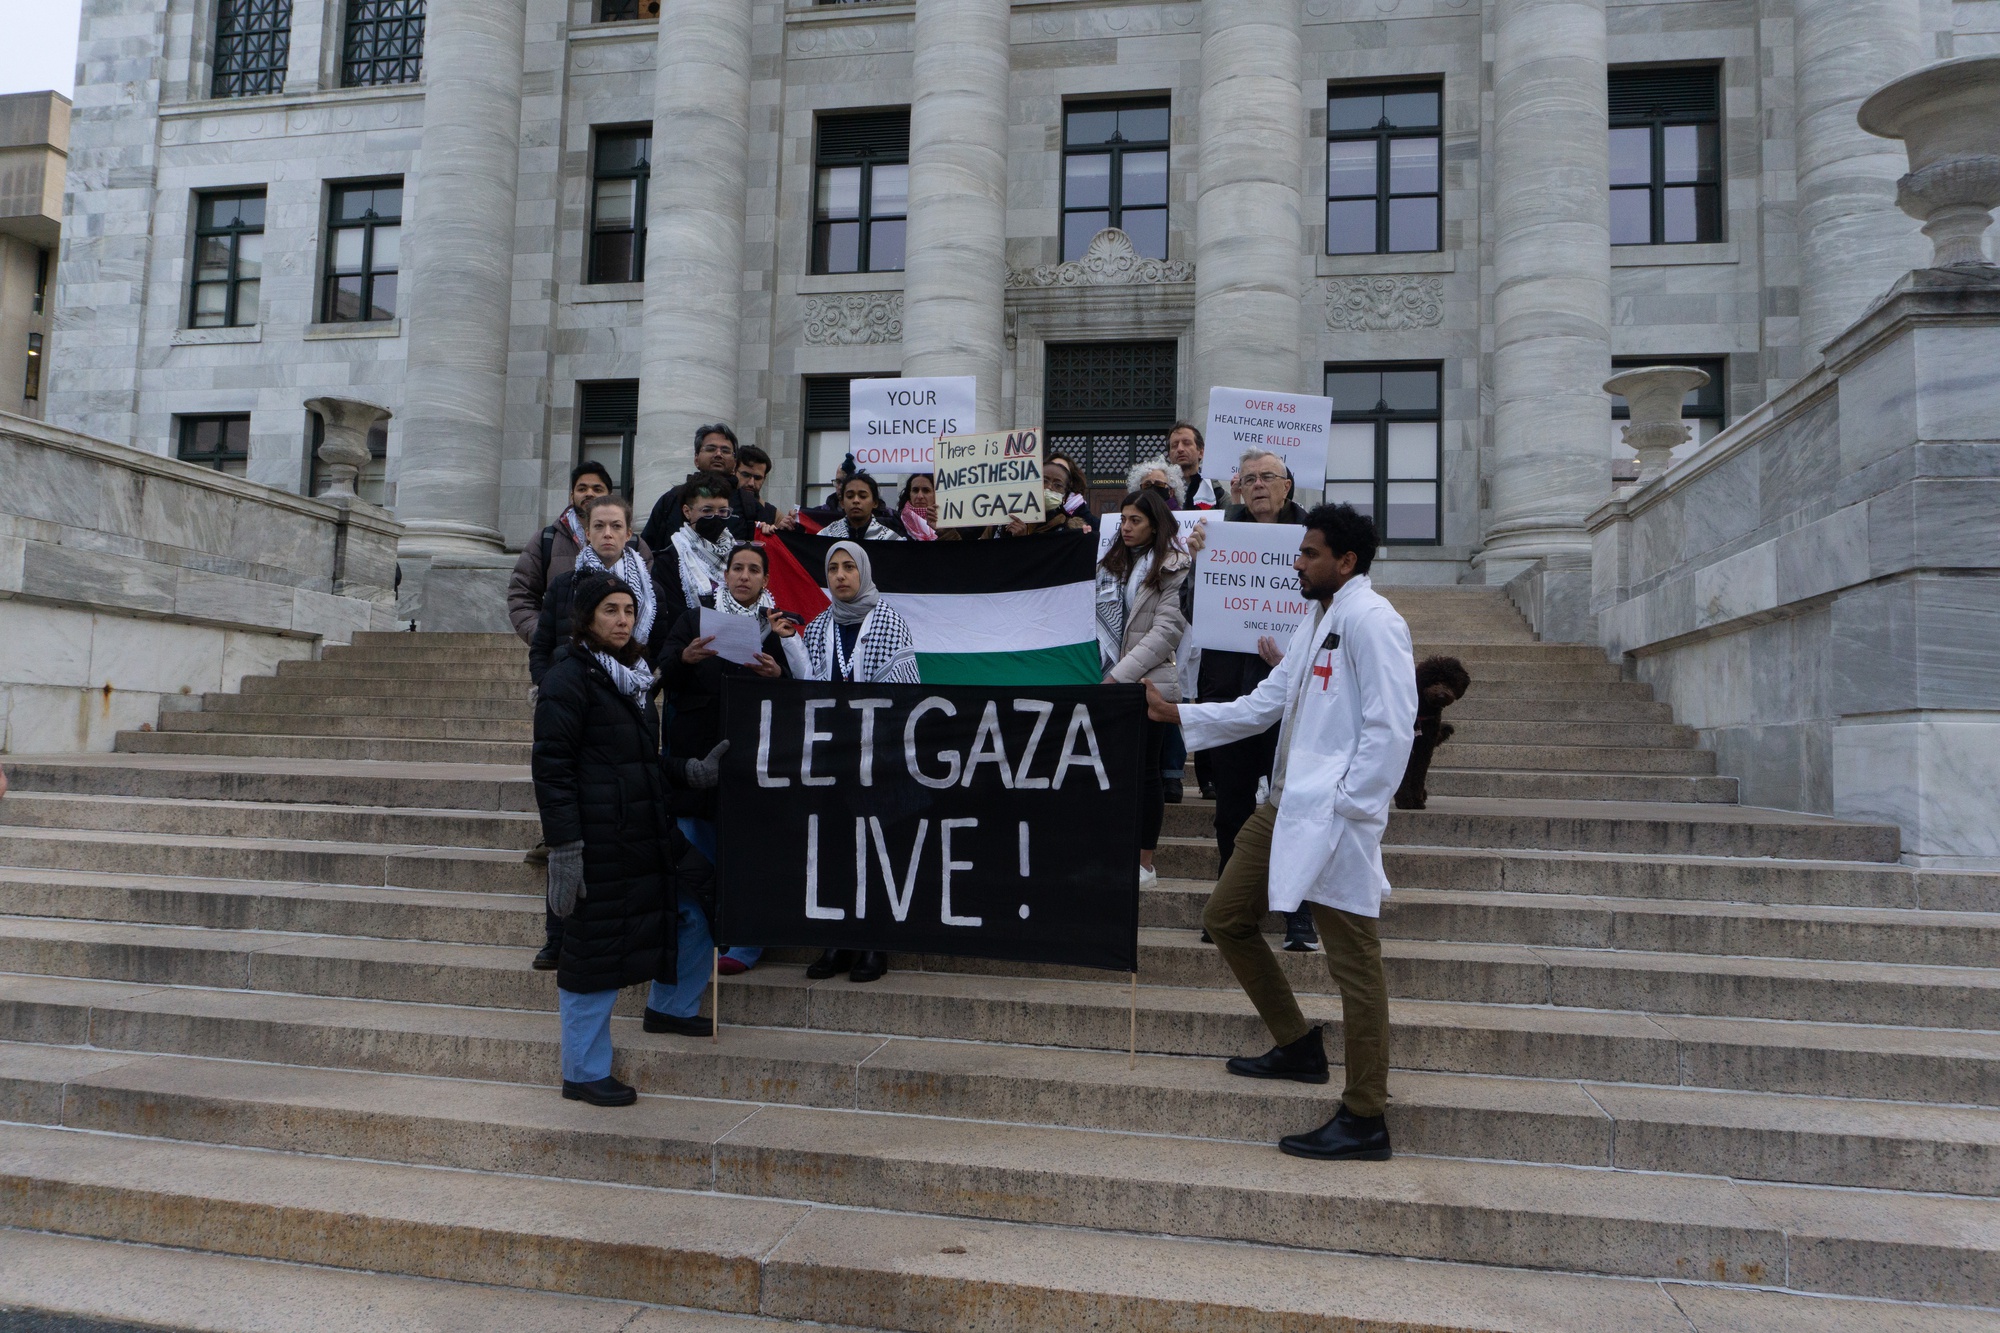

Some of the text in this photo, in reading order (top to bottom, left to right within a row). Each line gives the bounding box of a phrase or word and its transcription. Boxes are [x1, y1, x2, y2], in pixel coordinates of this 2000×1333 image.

[887, 390, 937, 406] YOUR
[1245, 399, 1296, 413] OVER 458
[867, 418, 957, 435] SILENCE IS
[1214, 413, 1323, 433] HEALTHCARE WORKERS
[938, 431, 1036, 459] There is NO
[1233, 431, 1301, 447] WERE KILLED
[856, 448, 934, 464] COMPLIC
[935, 460, 1041, 490] ANESTHESIA
[972, 491, 1041, 518] GAZA
[1210, 549, 1301, 567] 25,000 CHIL
[1203, 572, 1246, 587] TEENS
[1250, 575, 1265, 588] IN
[1224, 596, 1259, 611] LOST
[1262, 600, 1272, 612] A
[1243, 620, 1268, 631] SINCE
[756, 696, 1110, 791] LET GAZA
